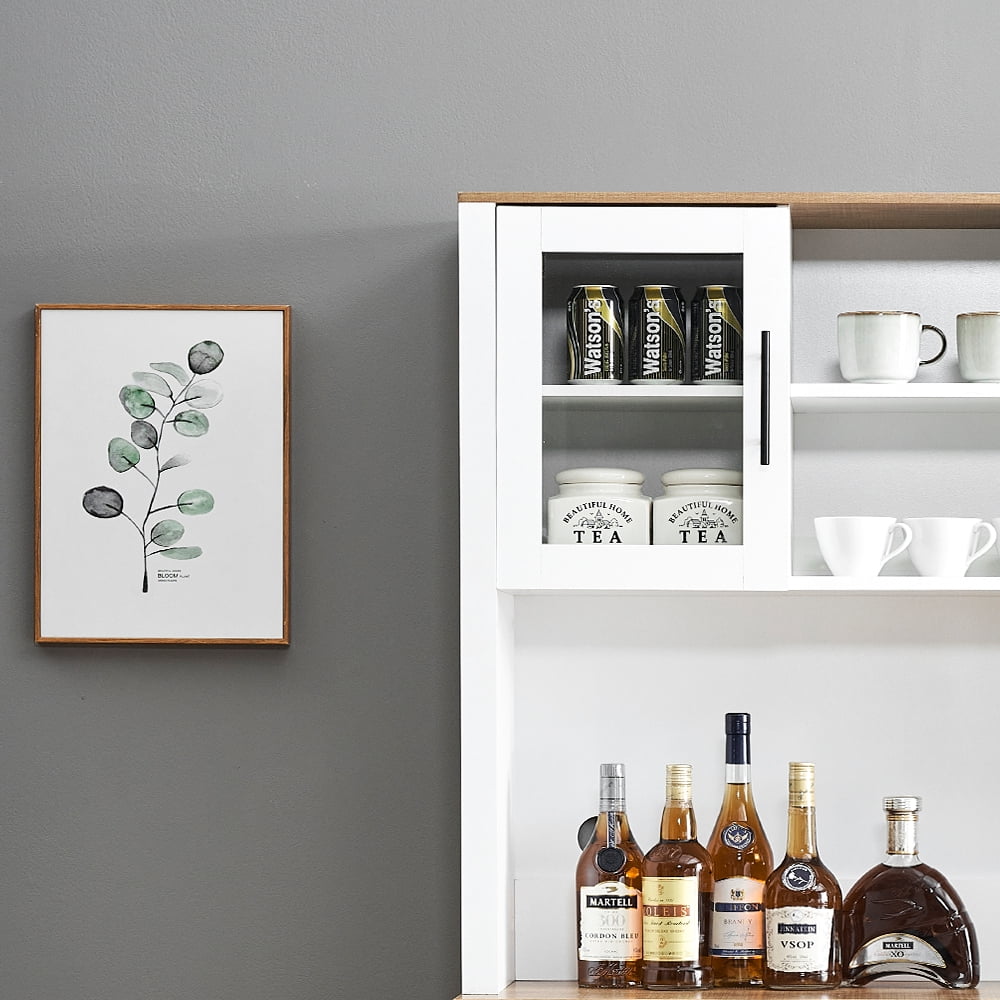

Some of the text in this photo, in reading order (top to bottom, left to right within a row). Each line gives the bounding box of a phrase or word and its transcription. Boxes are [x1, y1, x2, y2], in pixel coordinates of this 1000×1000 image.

[584, 299, 602, 376] Watson's
[643, 299, 661, 376] Watson's
[705, 299, 723, 376] Watson's
[562, 501, 633, 524] BEAUTIFUL HOME
[668, 501, 739, 524] BEAUTIFUL HOME
[590, 897, 633, 907] MARTELL
[780, 940, 814, 949] VSOP
[890, 950, 905, 958] XO
